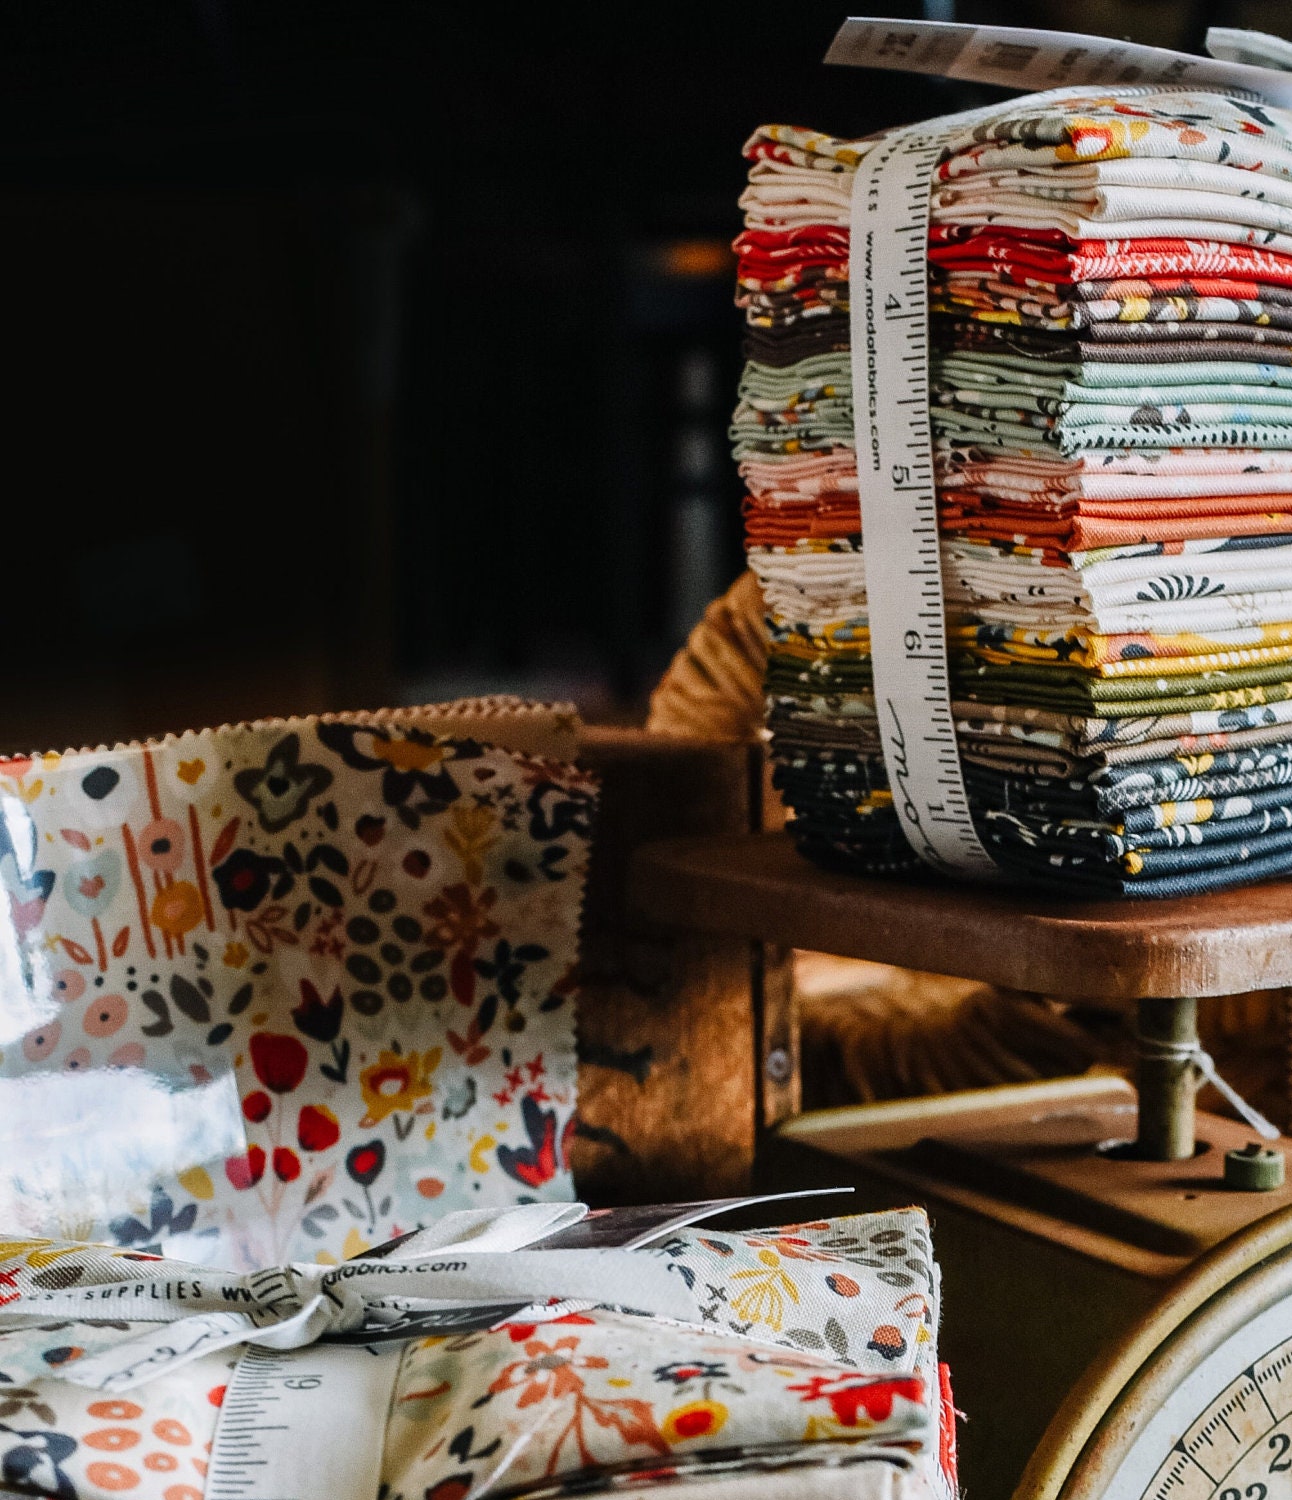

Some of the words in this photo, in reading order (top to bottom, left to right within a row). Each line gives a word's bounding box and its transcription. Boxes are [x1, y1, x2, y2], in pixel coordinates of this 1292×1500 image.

[865, 231, 880, 471] www.modafabrics.com
[892, 464, 910, 485] 5
[904, 629, 922, 651] 6
[85, 1280, 203, 1300] SUPPLIES
[283, 1377, 322, 1390] 6
